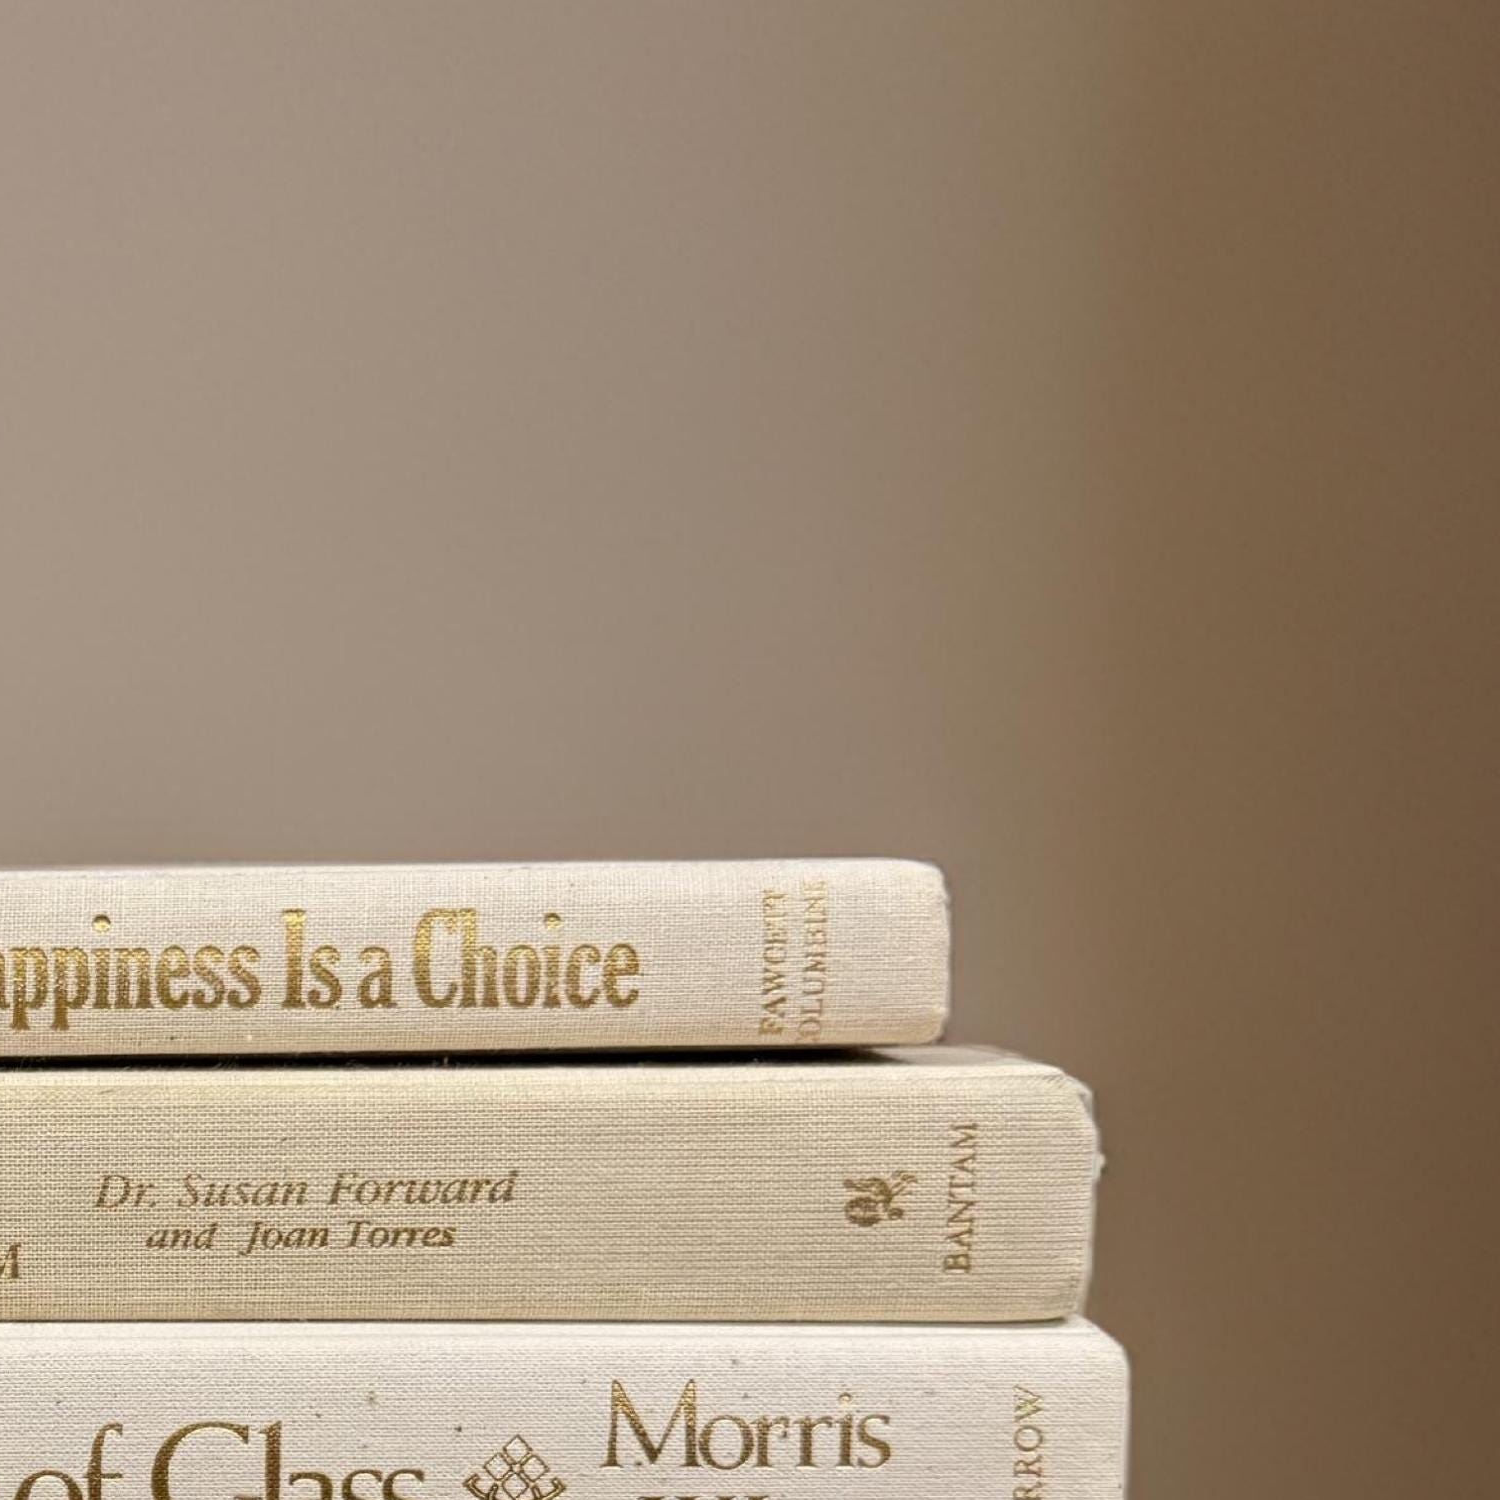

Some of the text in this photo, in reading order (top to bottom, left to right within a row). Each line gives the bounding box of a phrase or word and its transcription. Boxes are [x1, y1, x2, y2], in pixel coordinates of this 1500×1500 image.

[282, 908, 343, 1010] Is
[360, 944, 397, 1010] a
[414, 908, 641, 1010] Choice
[94, 1169, 519, 1209] Dr. Susan Forward
[943, 1121, 979, 1274] BANTAM
[145, 1219, 457, 1256] and Joan Torres
[599, 1378, 893, 1471] Morris
